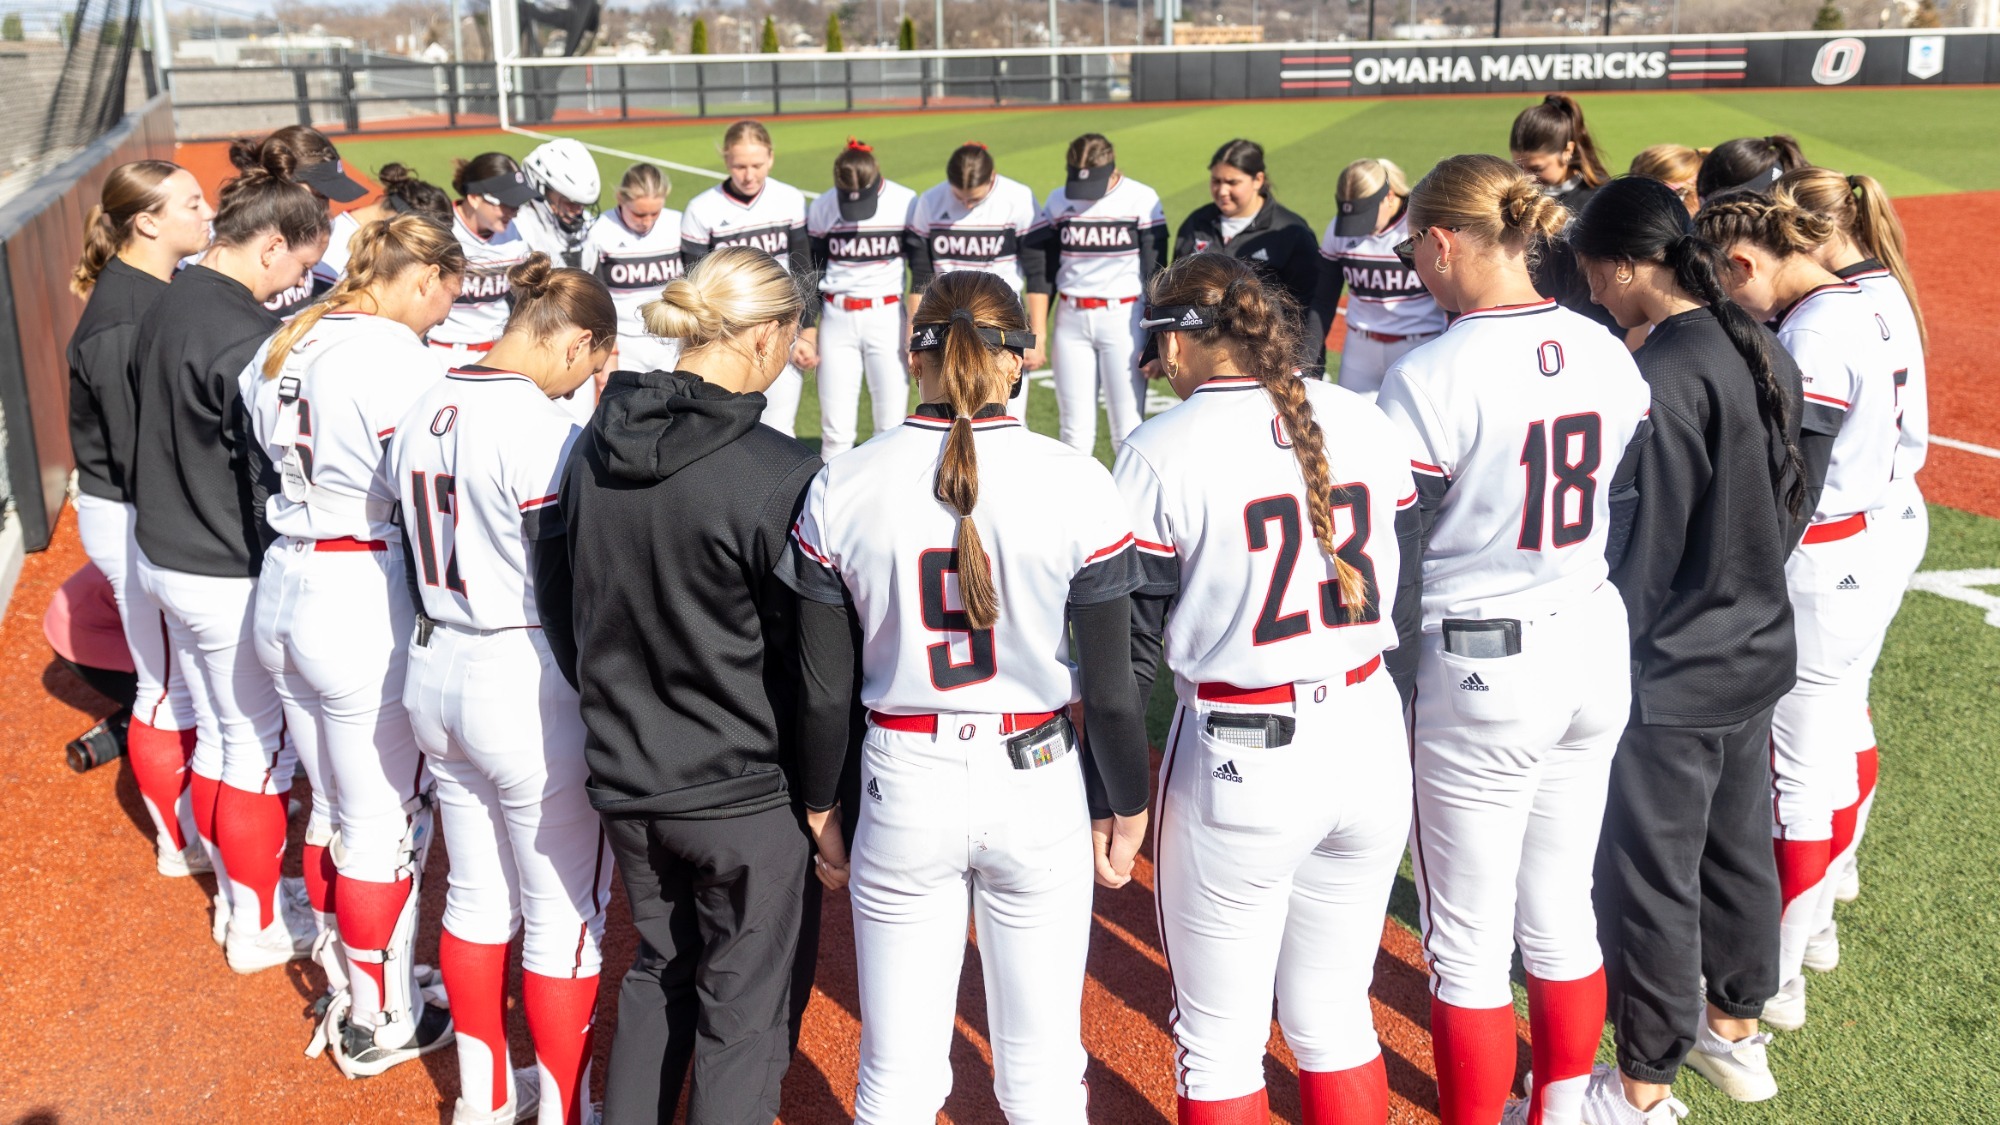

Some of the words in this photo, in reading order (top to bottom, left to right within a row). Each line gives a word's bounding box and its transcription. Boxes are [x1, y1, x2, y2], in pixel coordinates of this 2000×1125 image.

[1354, 55, 1476, 85] OMAHA
[1481, 51, 1667, 83] MAVERICKS
[1811, 37, 1866, 85] O
[828, 235, 900, 257] OMAHA
[1060, 226, 1132, 246] OMAHA
[461, 274, 511, 298] MAH
[1342, 266, 1423, 291] OMAHA
[1537, 340, 1564, 377] O
[1517, 411, 1601, 552] 18
[1243, 481, 1380, 647] 23
[1212, 770, 1243, 783] adidas
